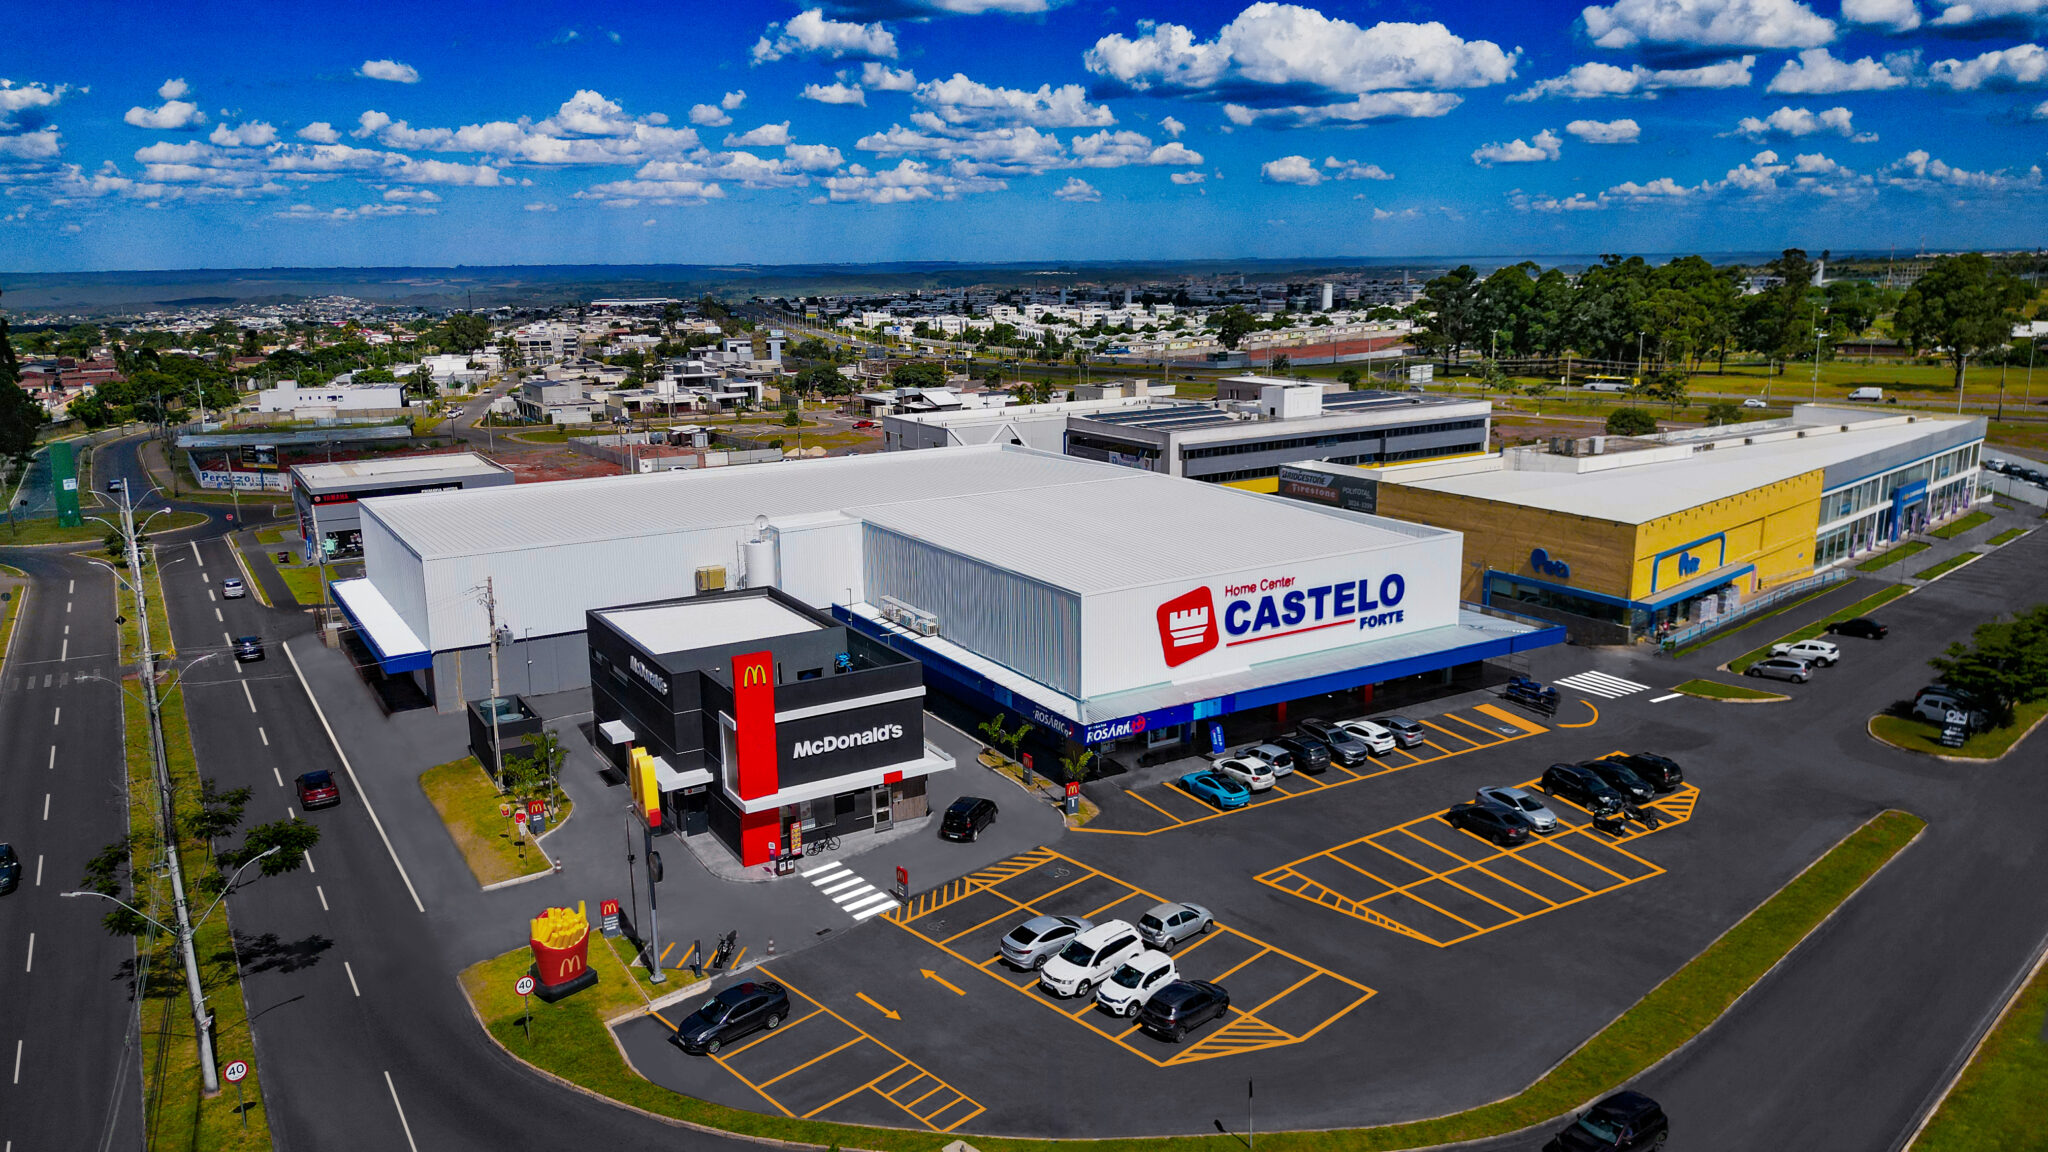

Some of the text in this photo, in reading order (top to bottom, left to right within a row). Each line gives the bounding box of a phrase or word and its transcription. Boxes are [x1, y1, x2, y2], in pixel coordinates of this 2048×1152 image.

[1282, 470, 1326, 485] BRIDGESTONE
[323, 493, 349, 501] YAMAHA
[1292, 483, 1336, 498] Firestone
[1225, 577, 1295, 597] Home Center
[1224, 573, 1405, 636] CASTELO
[1360, 610, 1404, 630] FORTE
[793, 723, 903, 759] McDonald's
[518, 979, 532, 990] 40
[228, 1064, 244, 1075] 40
